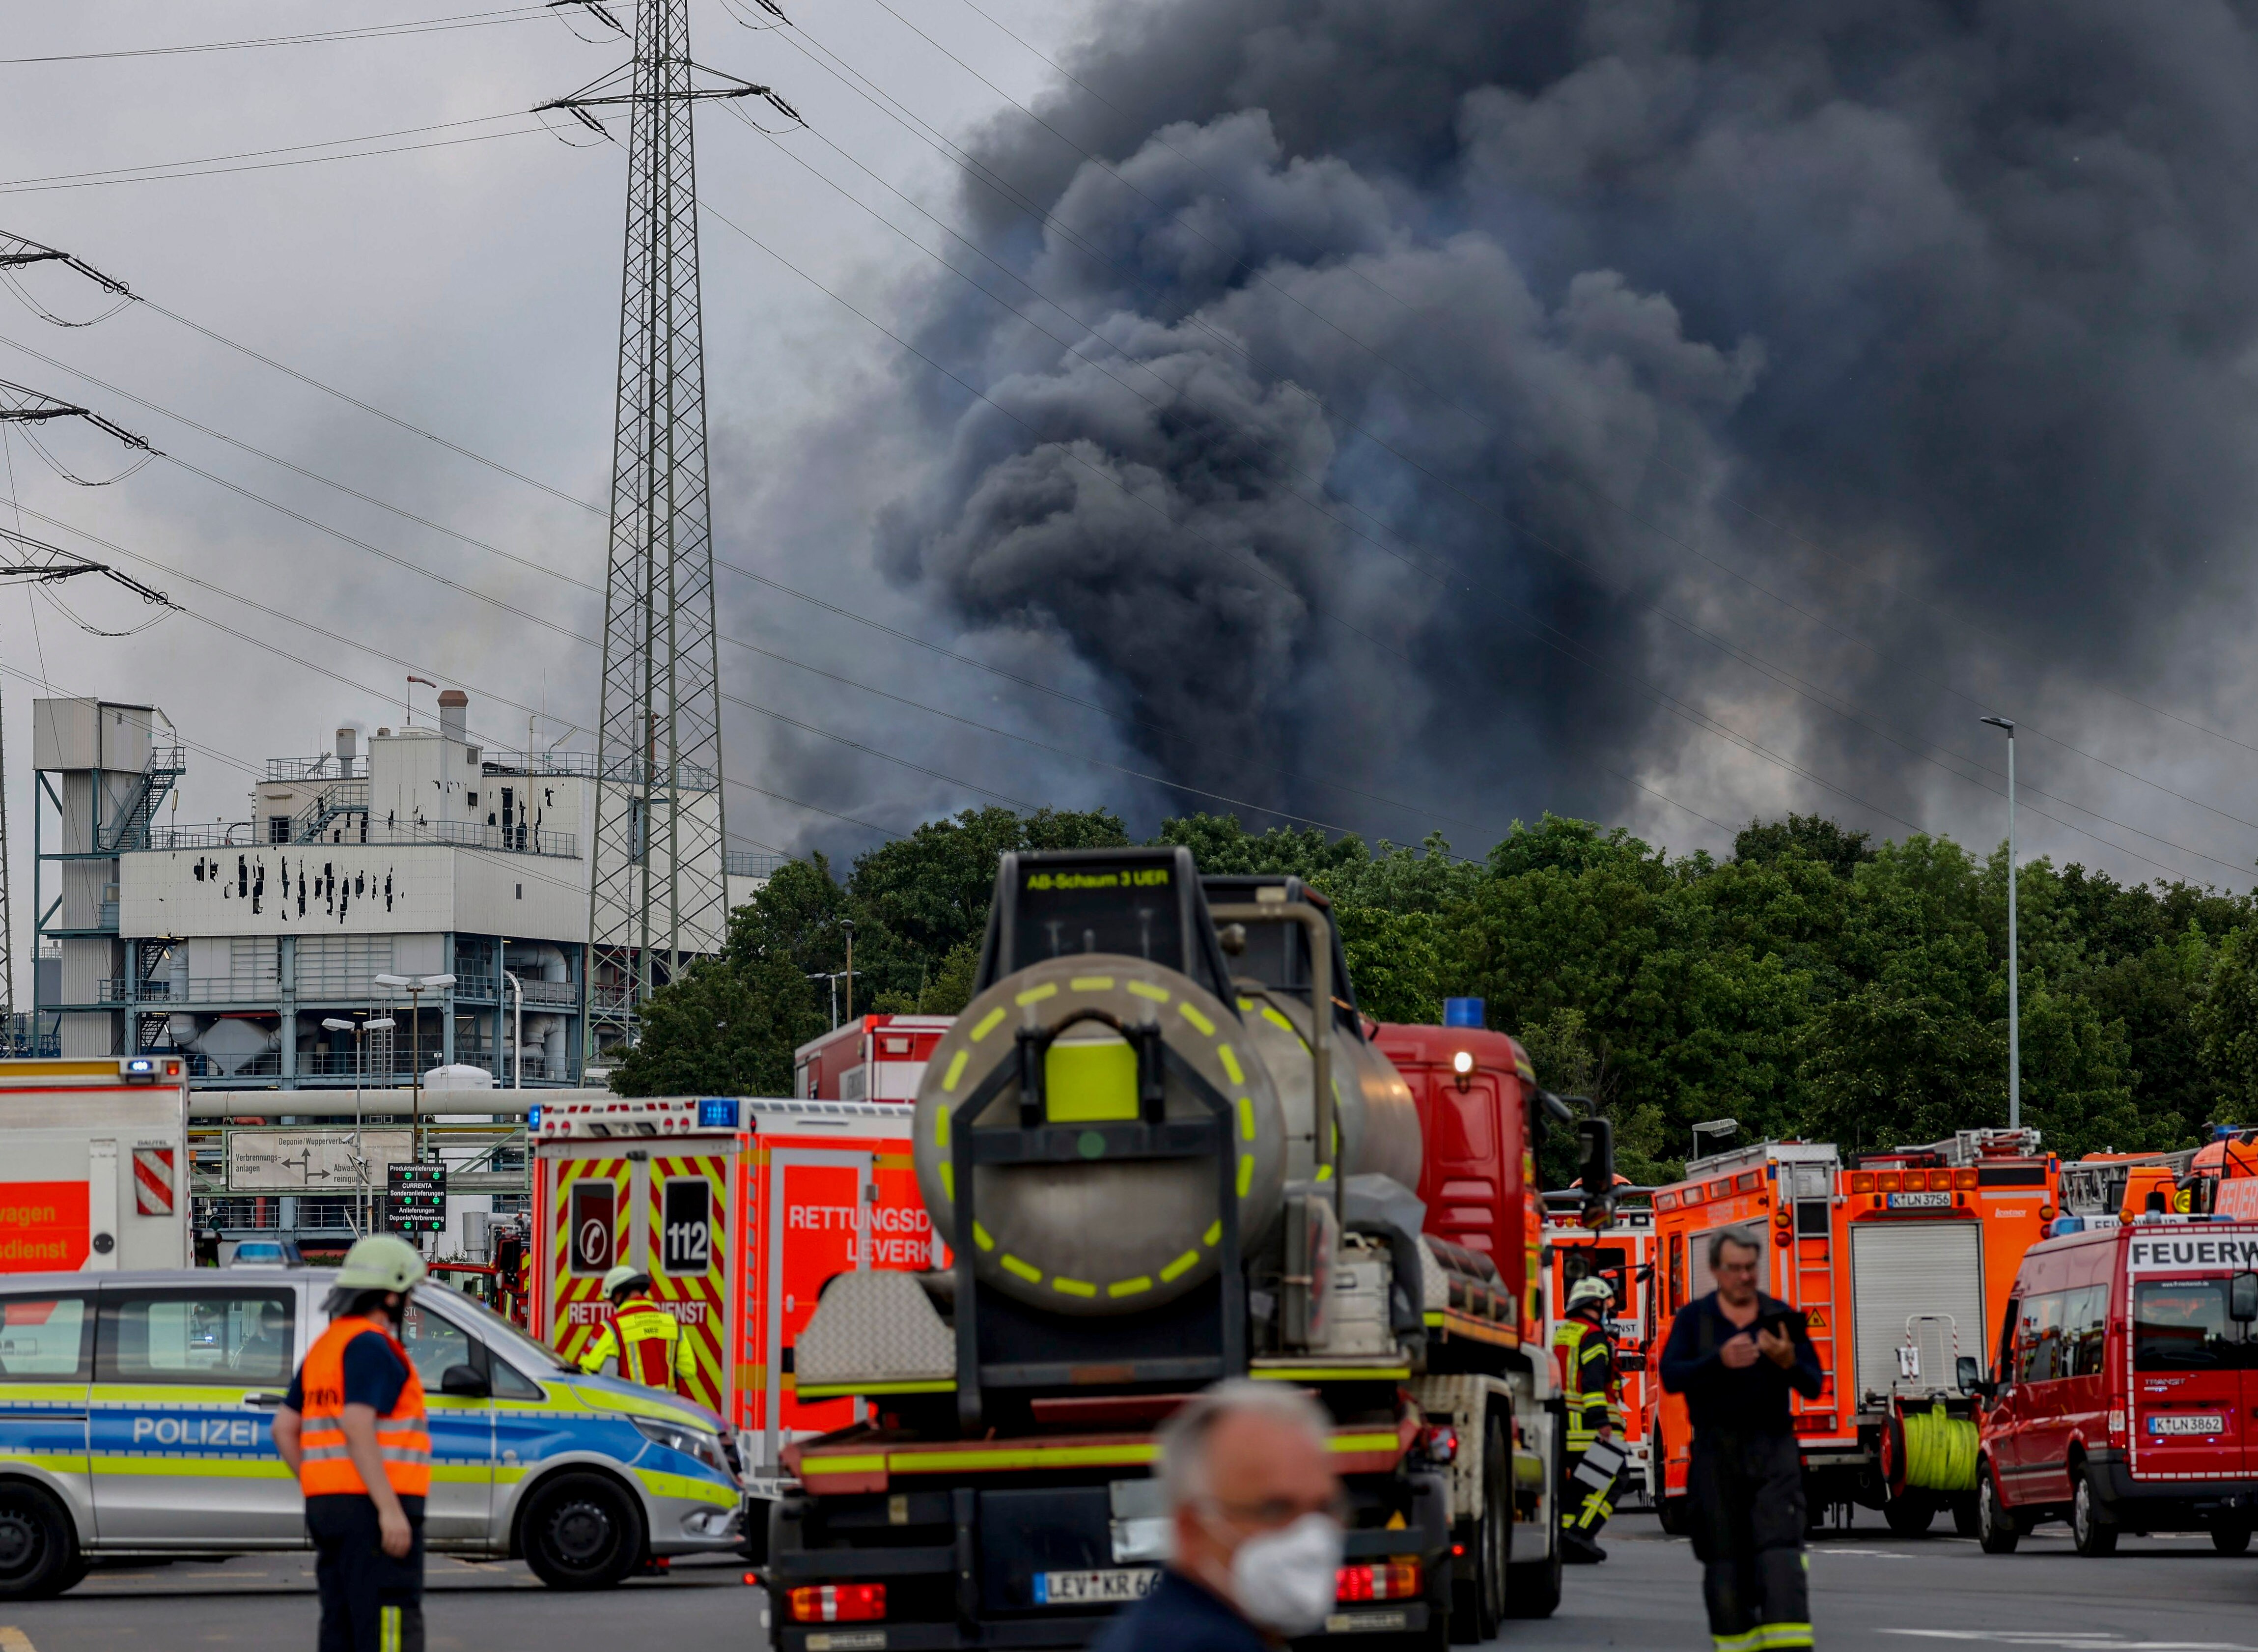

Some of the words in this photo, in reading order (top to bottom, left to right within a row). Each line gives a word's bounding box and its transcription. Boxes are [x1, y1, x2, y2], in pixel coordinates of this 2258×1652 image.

[236, 1153, 281, 1162] Verbrennungs-
[236, 1164, 260, 1173] anlagen
[334, 1163, 363, 1172] Abwassr
[334, 1174, 363, 1184] reinigug
[1894, 1196, 1900, 1205] K
[1907, 1195, 1921, 1205] LN
[1923, 1194, 1949, 1205] 3756
[667, 1221, 707, 1260] 112
[0, 1239, 67, 1259] dienst
[2157, 1420, 2164, 1430] K
[2172, 1419, 2188, 1430] LN
[2191, 1418, 2219, 1430] 3862
[133, 1417, 258, 1446] POLIZEI
[1049, 1577, 1087, 1596] LEV
[1104, 1574, 1129, 1595] KR
